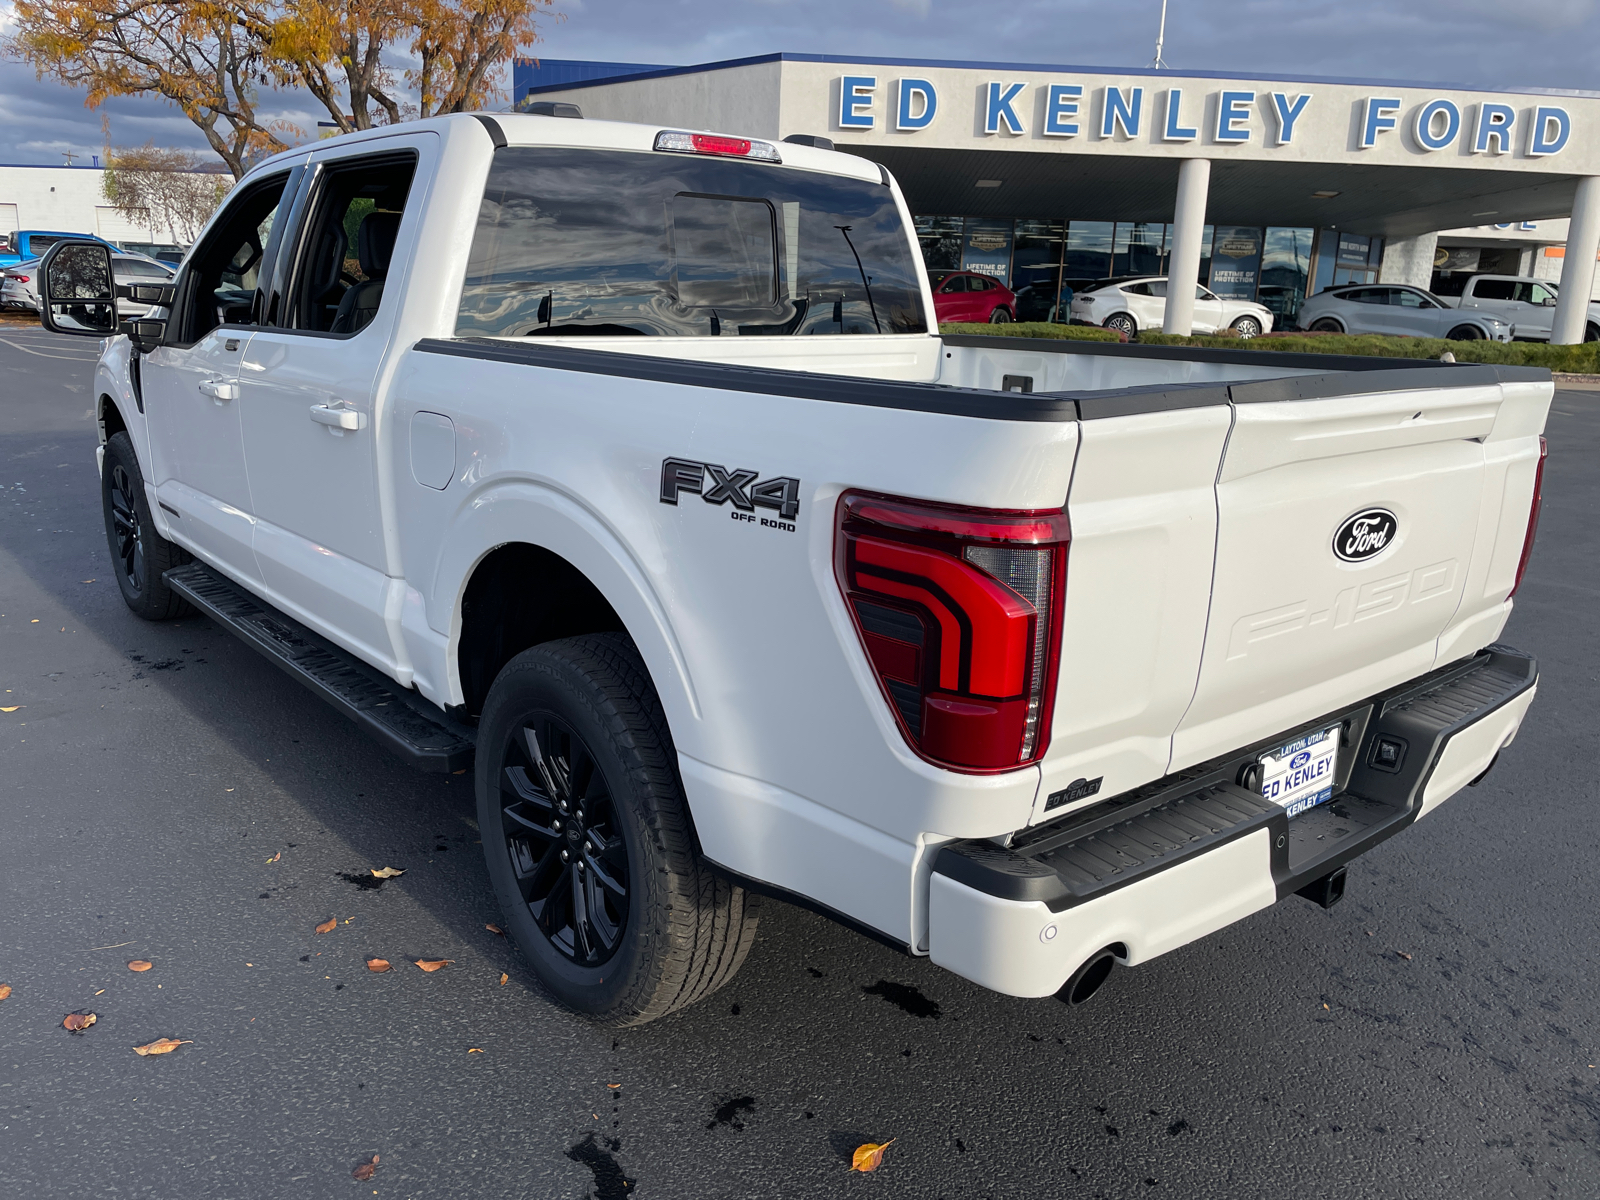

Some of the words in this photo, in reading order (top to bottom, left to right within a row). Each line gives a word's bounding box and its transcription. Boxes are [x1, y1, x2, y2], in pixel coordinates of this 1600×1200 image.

[837, 74, 939, 131] ED
[983, 81, 1313, 147] KENLEY
[1357, 97, 1574, 158] FORD
[659, 456, 801, 522] FX4
[731, 511, 757, 523] OFF
[760, 517, 796, 533] ROAD
[1225, 557, 1459, 662] F-150
[1307, 731, 1324, 747] UTAH
[1046, 796, 1060, 808] ED
[1062, 781, 1101, 803] KENLEY
[1262, 780, 1280, 800] ED
[1284, 755, 1333, 792] KENLEY
[1286, 793, 1318, 819] KENLEY
